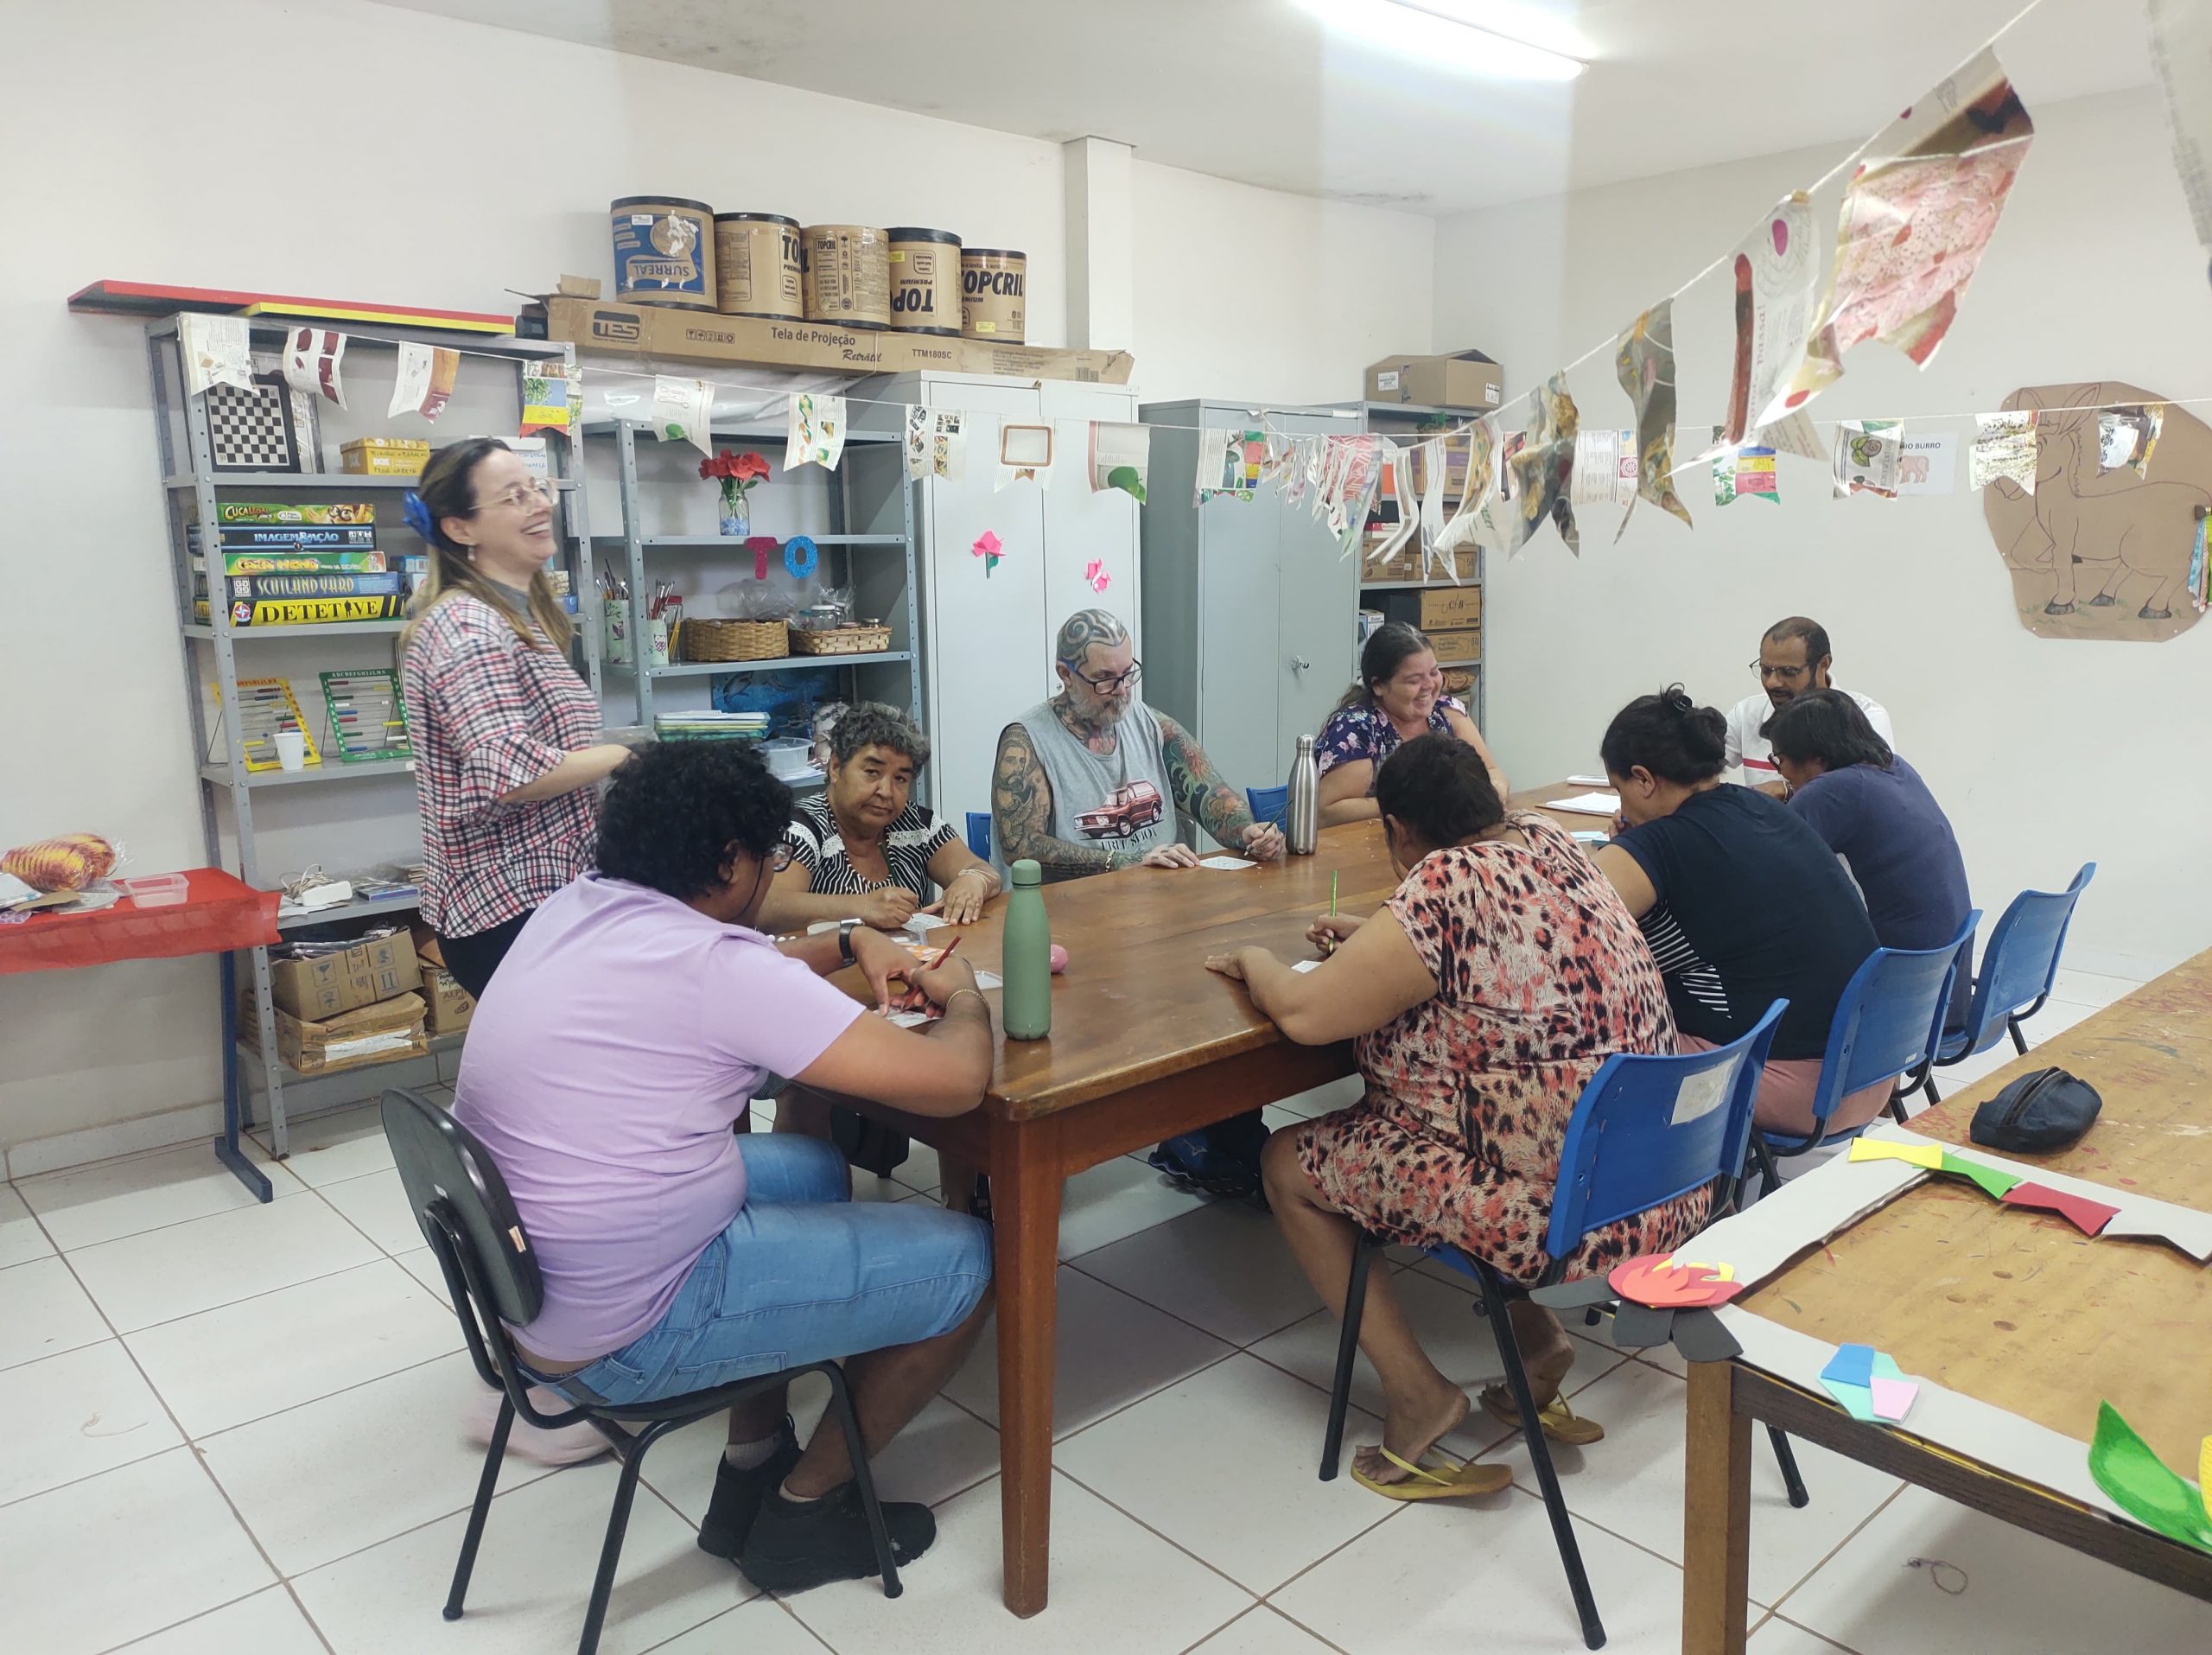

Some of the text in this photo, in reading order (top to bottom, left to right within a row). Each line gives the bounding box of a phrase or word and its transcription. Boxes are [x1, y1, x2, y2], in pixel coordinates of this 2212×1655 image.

[817, 240, 836, 250] TOPCRIL
[633, 264, 690, 277] SURREAL
[961, 271, 1023, 297] OPCRIL
[771, 327, 856, 347] Tela de Projeção
[912, 348, 952, 360] TTM180SC
[225, 505, 248, 520] CUCA
[257, 576, 318, 595] SCOTLAND
[320, 576, 354, 594] YARD
[262, 600, 378, 623] DETETIVE
